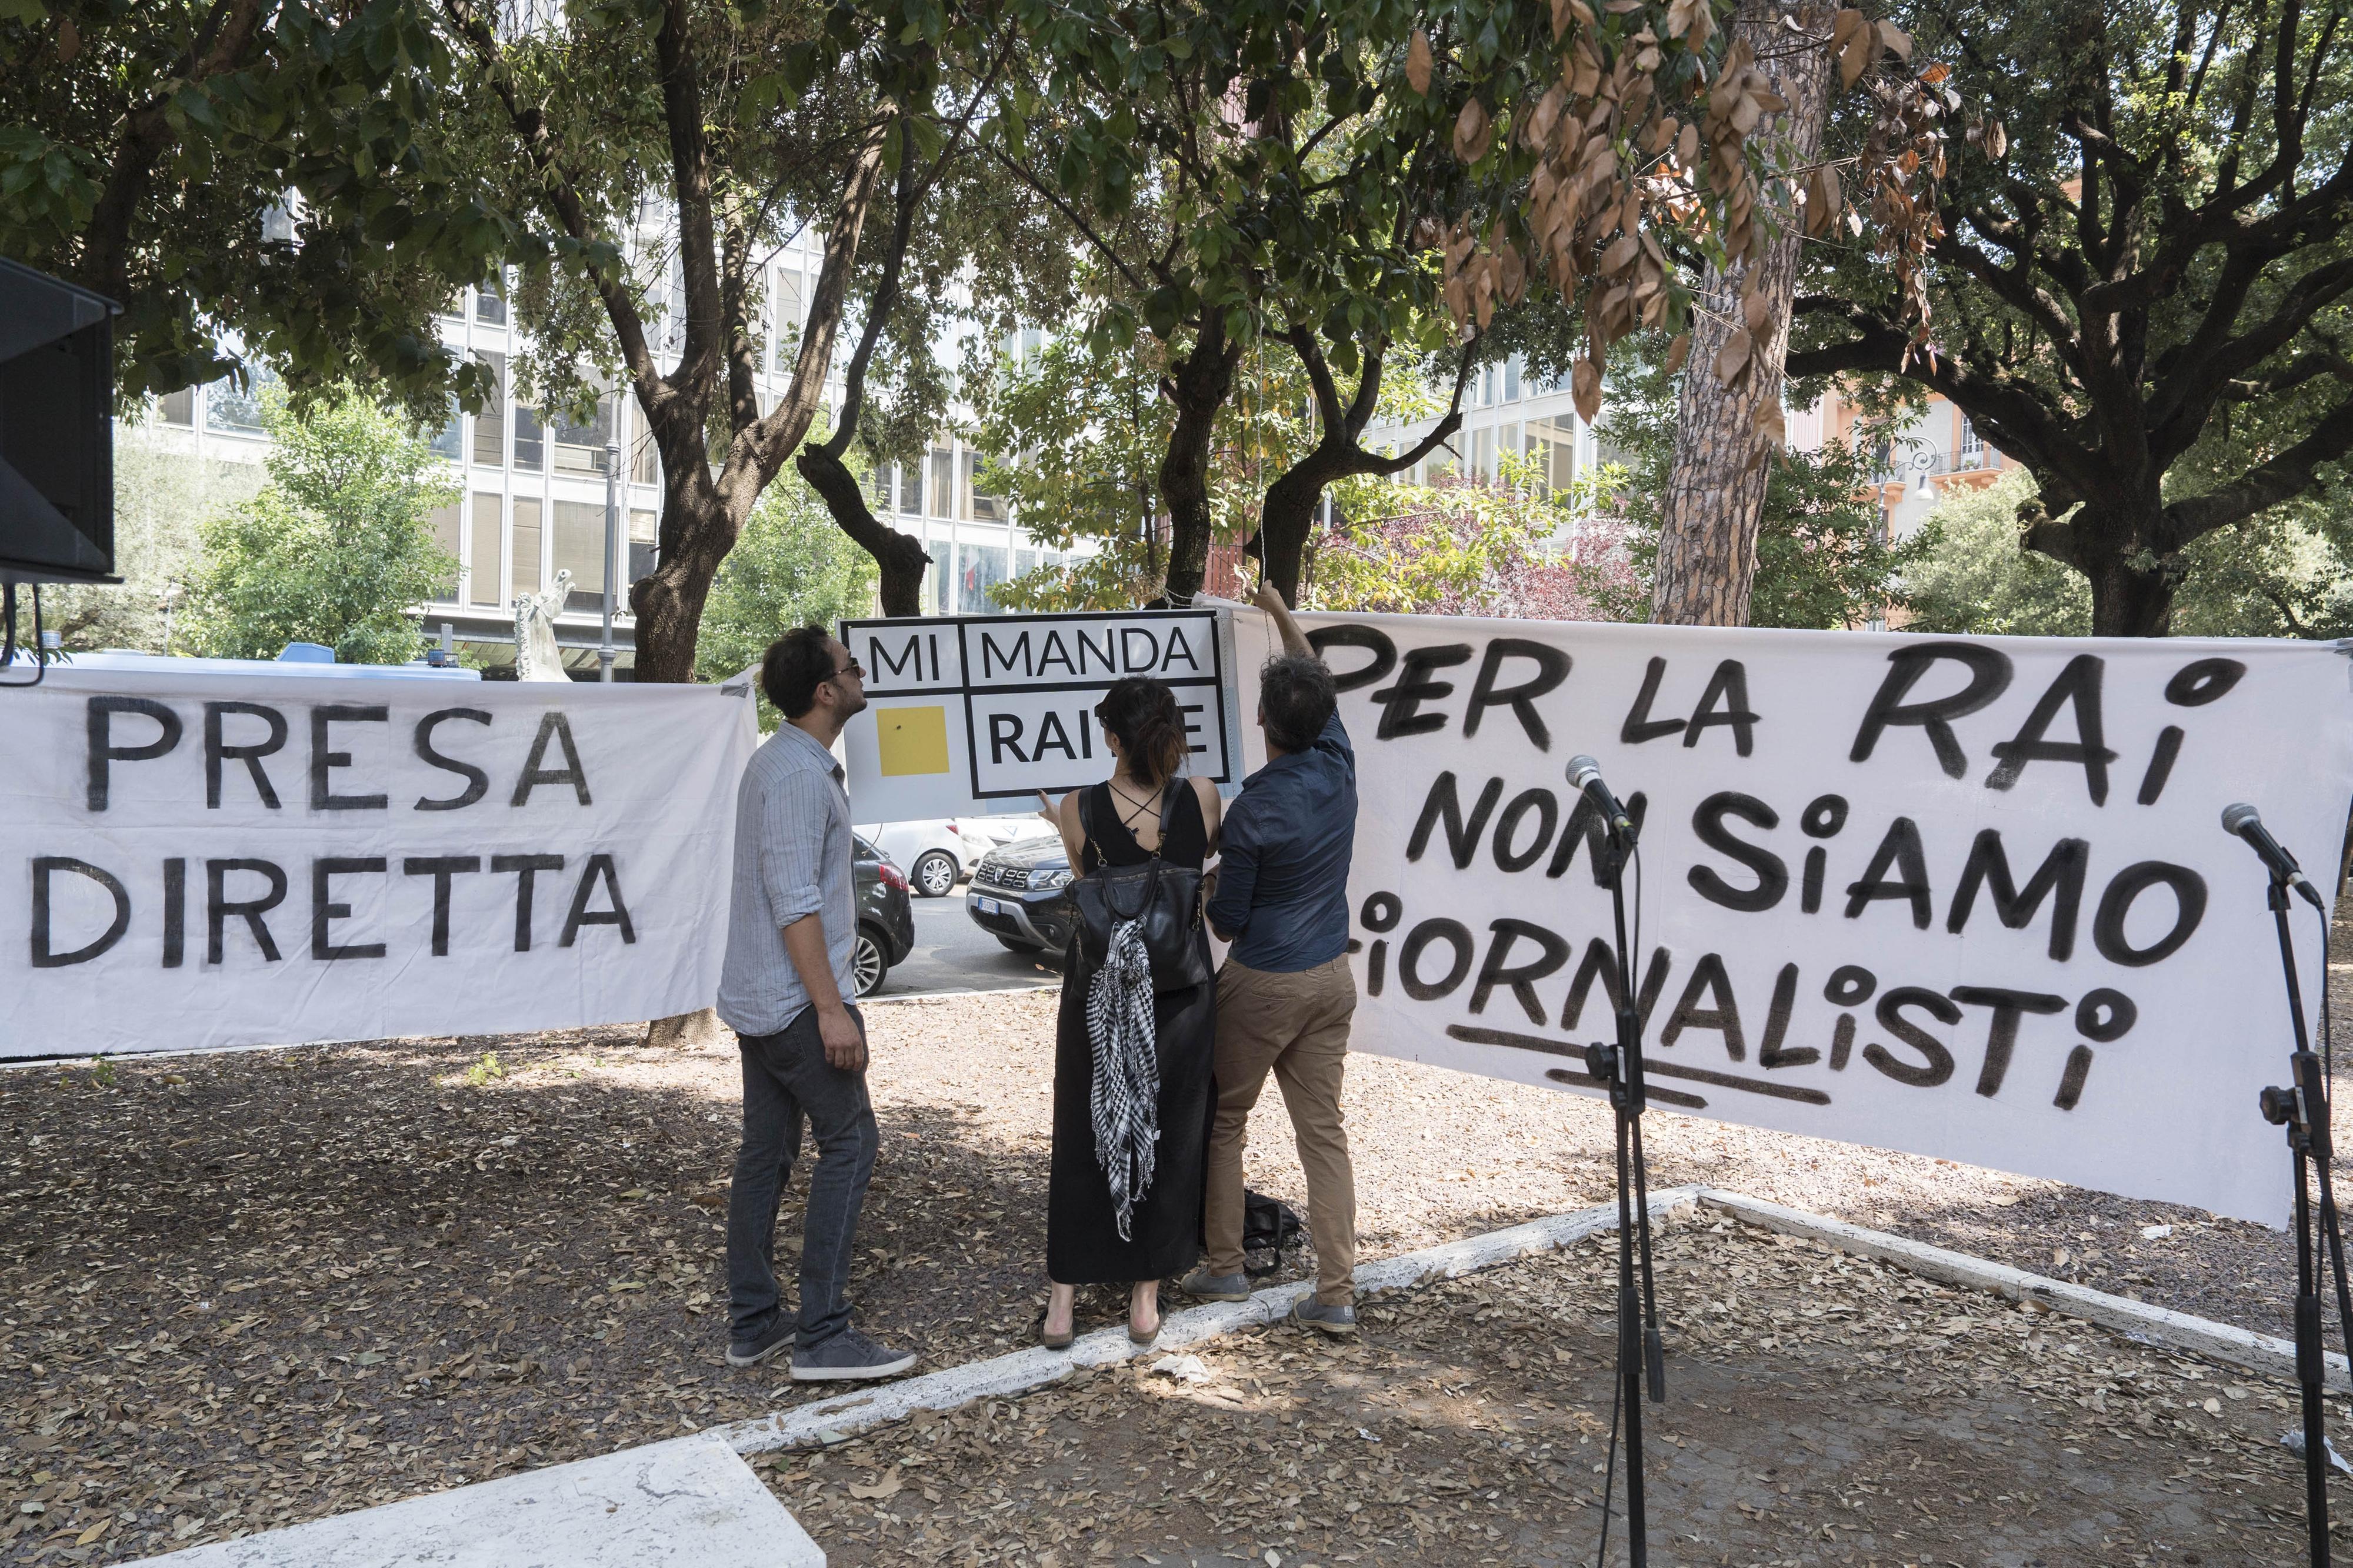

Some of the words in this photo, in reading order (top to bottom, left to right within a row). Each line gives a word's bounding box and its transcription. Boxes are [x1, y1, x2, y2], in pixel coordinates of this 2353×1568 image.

[869, 635, 939, 684] MI
[982, 626, 1198, 679] MANDA
[1621, 656, 1761, 757] LA
[86, 696, 592, 812] PRESA
[989, 704, 1207, 765] RAIE
[1405, 770, 1648, 890] NON
[31, 853, 636, 968] DIRETTA
[1348, 891, 2137, 1110] iORNALiSTi
